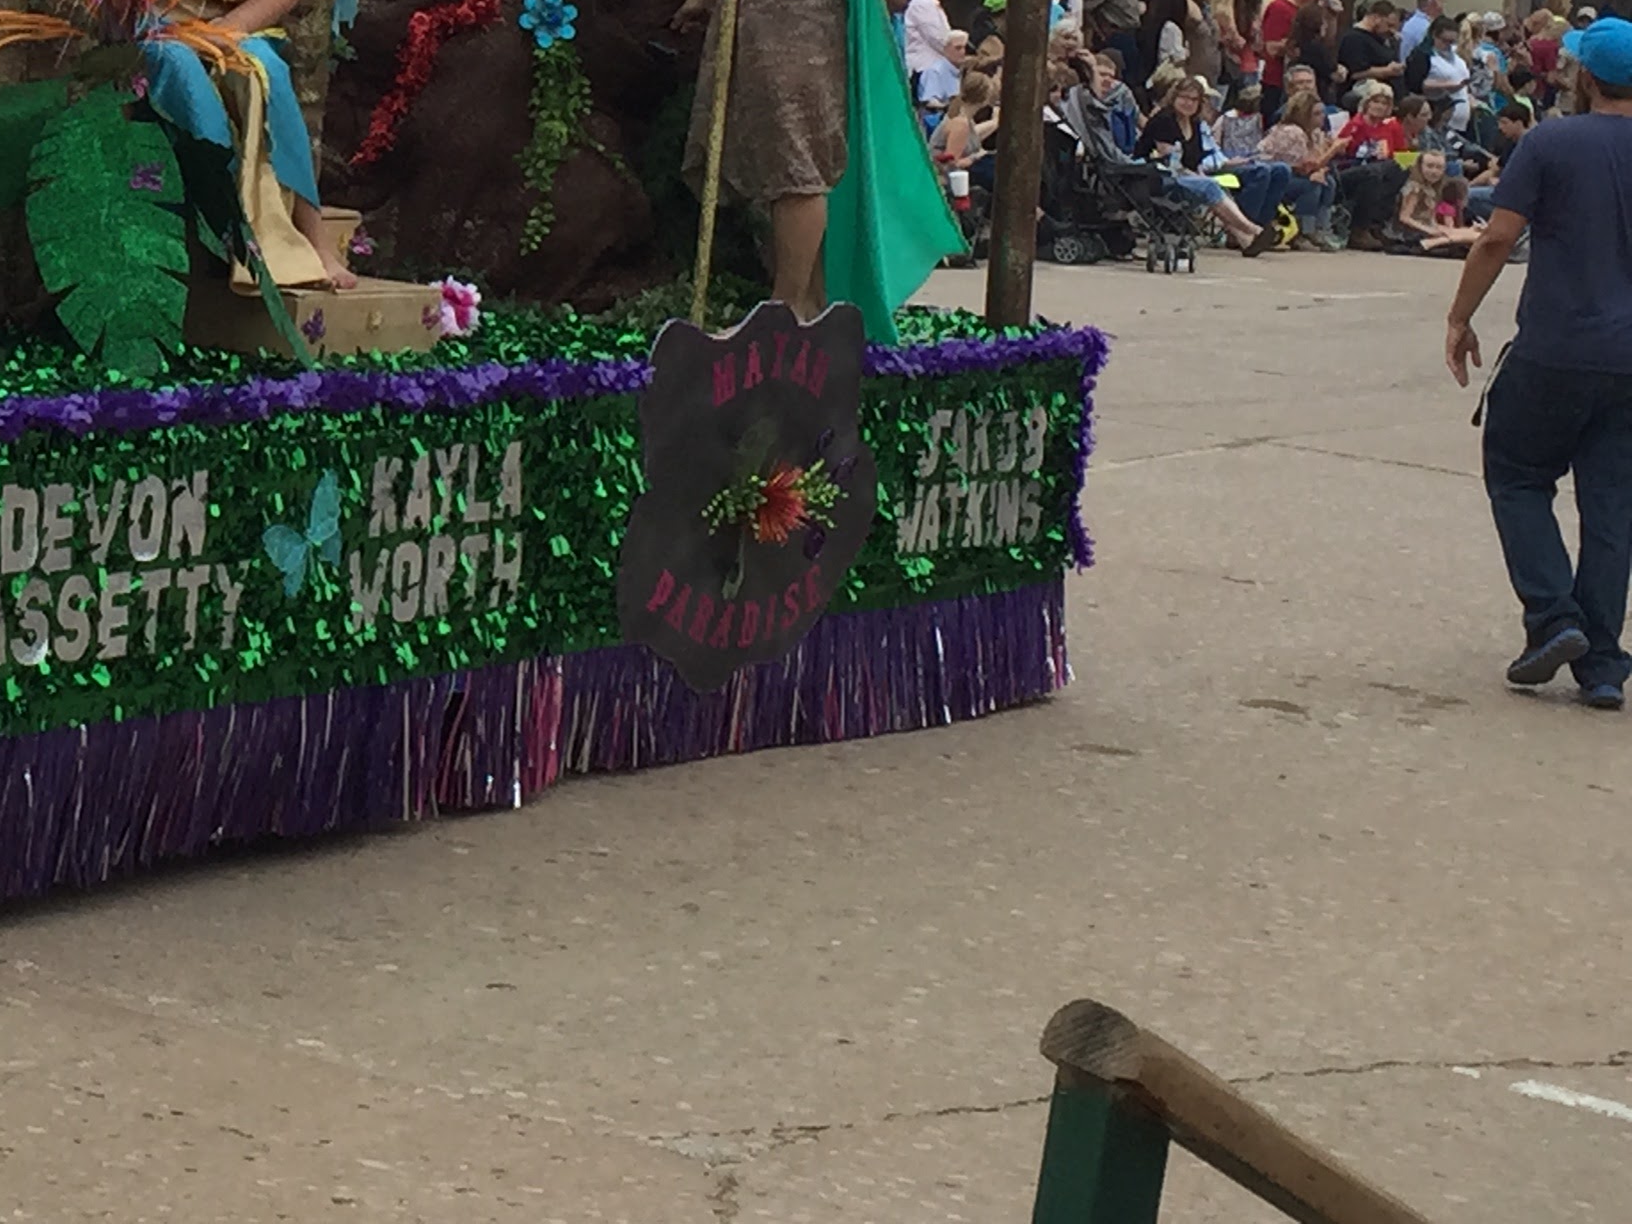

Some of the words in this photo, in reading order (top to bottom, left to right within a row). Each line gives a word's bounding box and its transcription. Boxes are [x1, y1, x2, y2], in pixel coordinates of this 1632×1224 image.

[712, 332, 831, 408] MAYAN
[0, 470, 209, 575] DEVON
[368, 441, 522, 538] KAYLA
[896, 478, 1044, 553] WATKINS
[349, 531, 523, 630] WORTH
[646, 565, 822, 649] PARADISE
